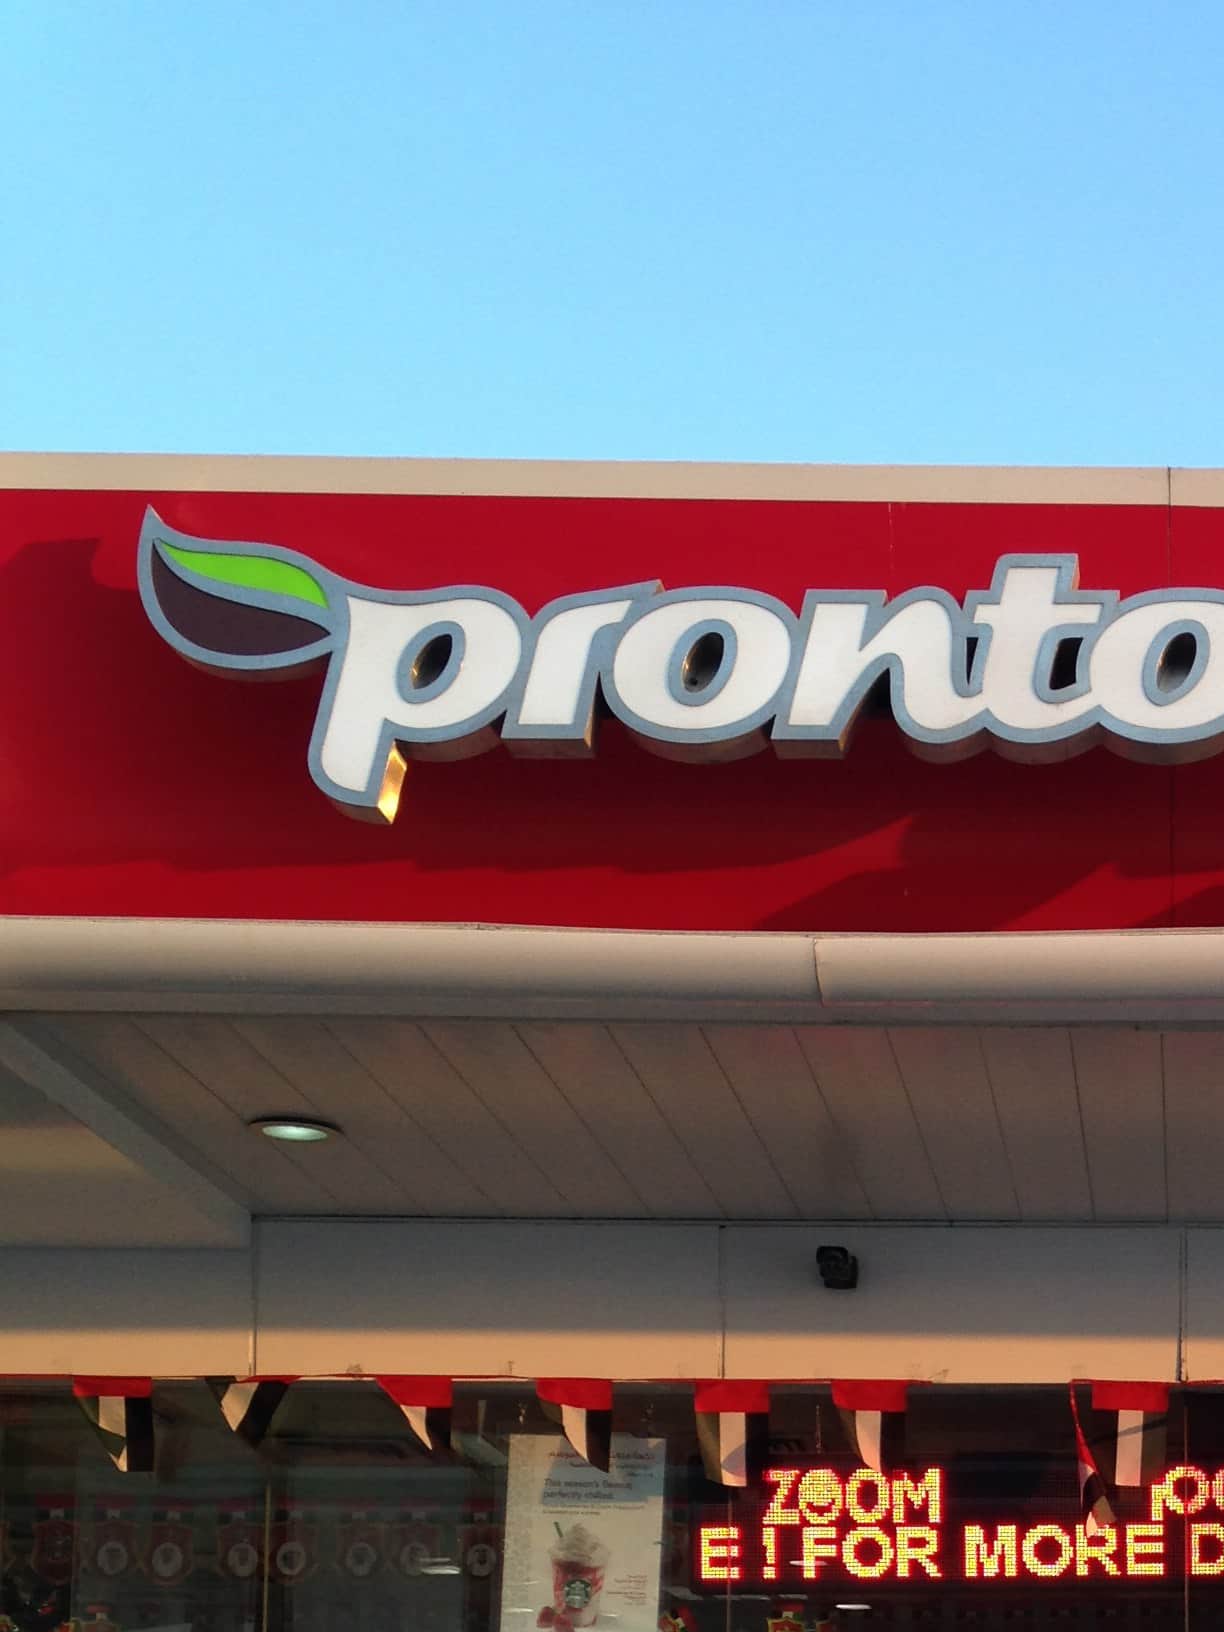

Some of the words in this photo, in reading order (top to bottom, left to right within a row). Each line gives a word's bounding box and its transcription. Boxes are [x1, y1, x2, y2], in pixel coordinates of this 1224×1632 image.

[763, 1468, 941, 1524] ZOOM
[801, 1526, 942, 1579] FOR
[964, 1523, 1164, 1577] MORE
